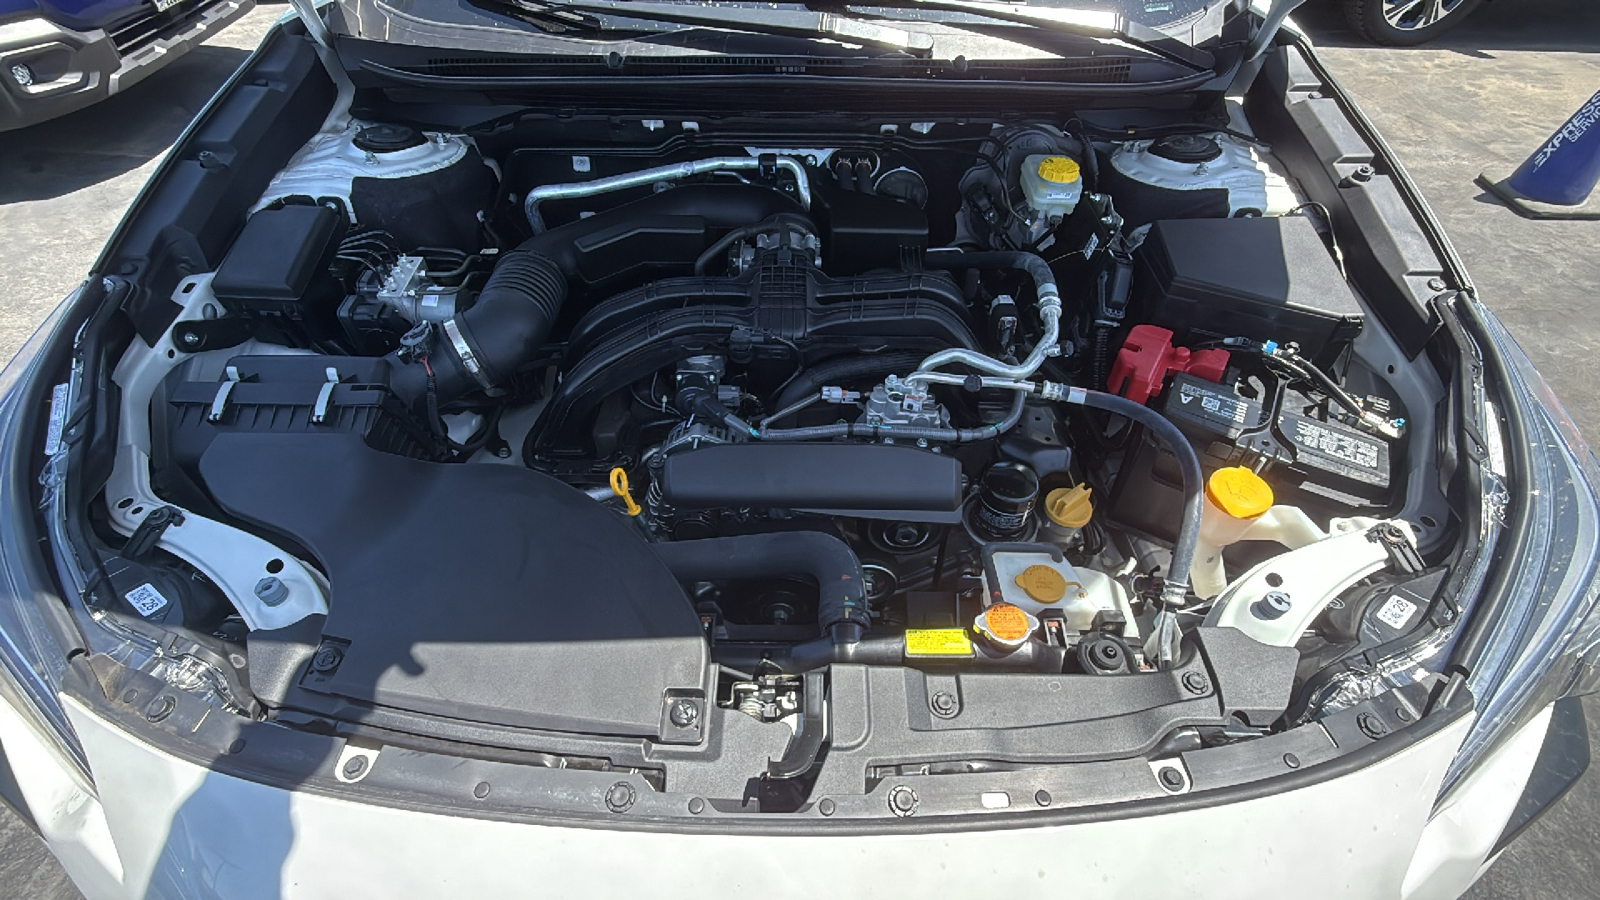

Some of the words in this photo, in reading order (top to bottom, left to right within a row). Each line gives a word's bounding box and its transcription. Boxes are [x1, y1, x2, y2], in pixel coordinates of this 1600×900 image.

[1532, 92, 1600, 173] EXPRESS
[142, 598, 159, 610] 28
[1393, 600, 1408, 612] 28
